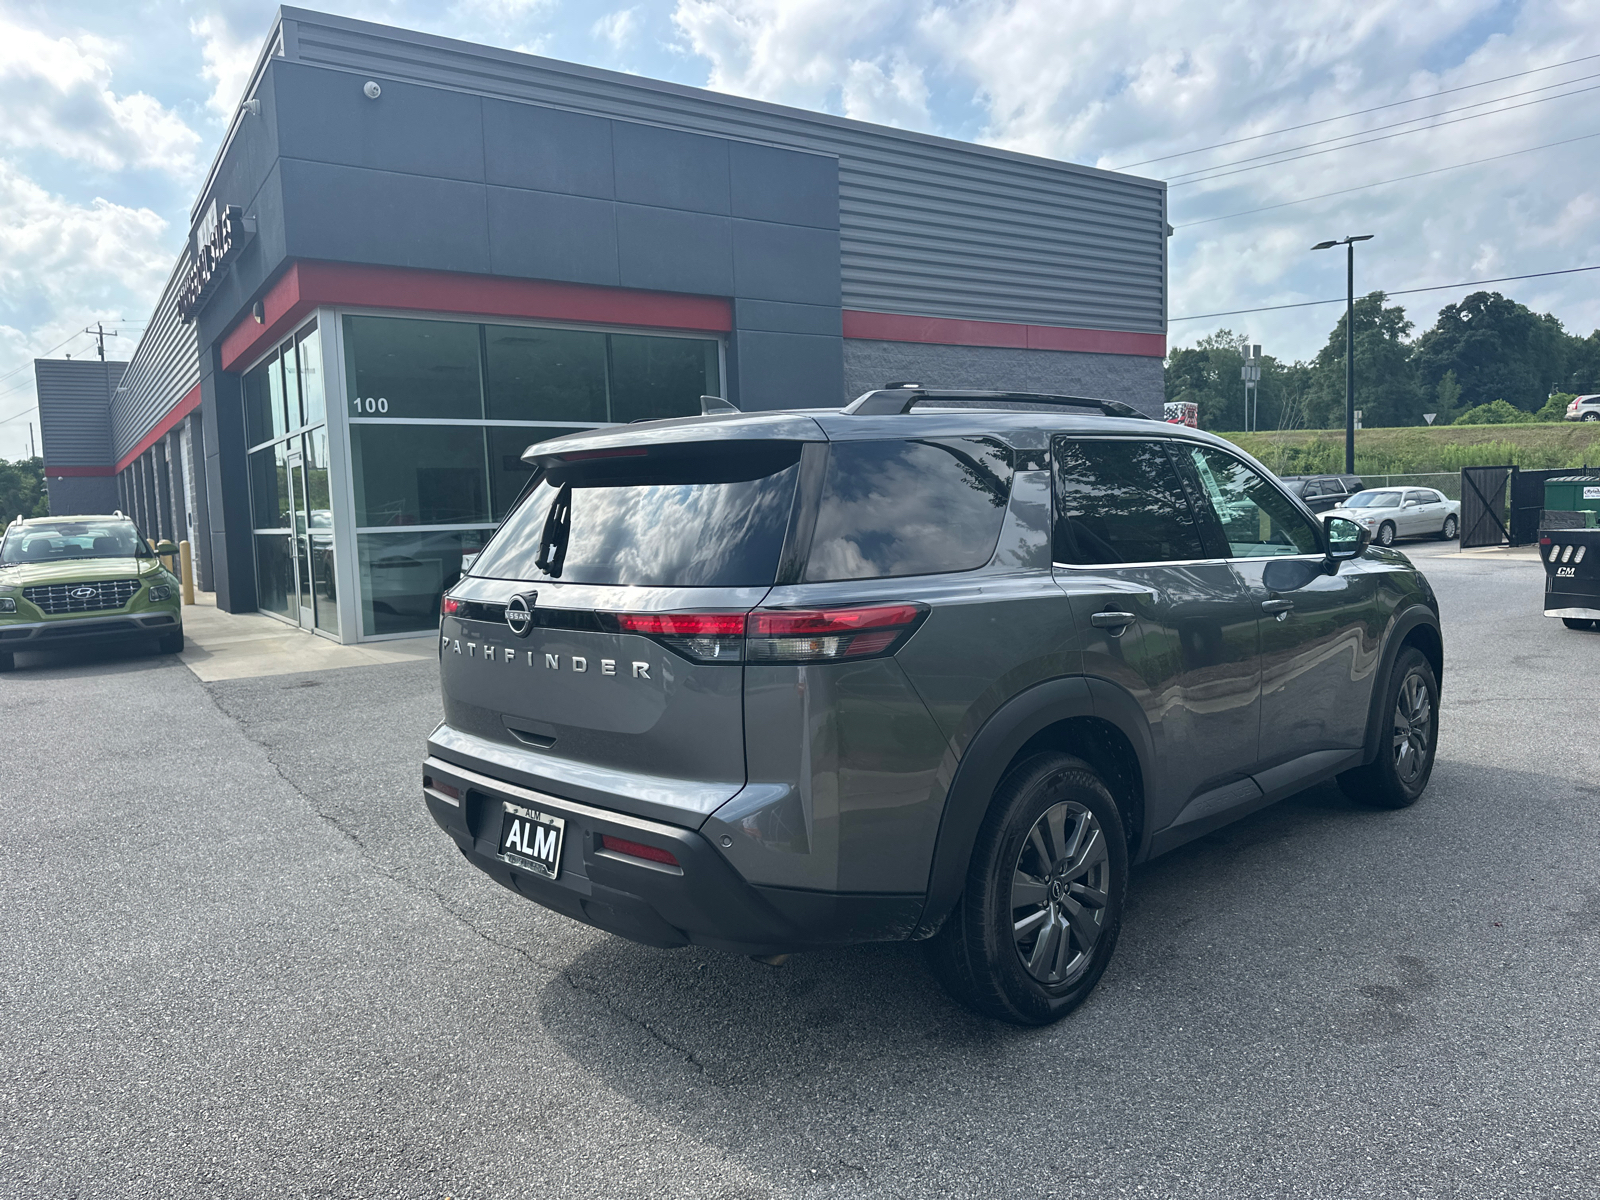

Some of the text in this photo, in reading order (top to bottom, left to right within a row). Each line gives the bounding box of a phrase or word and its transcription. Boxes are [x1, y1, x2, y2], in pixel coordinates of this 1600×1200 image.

[353, 397, 389, 413] 100
[505, 610, 531, 620] NISSAN
[442, 636, 651, 679] PATHFINDER
[525, 808, 541, 821] ALM
[505, 819, 557, 863] ALM
